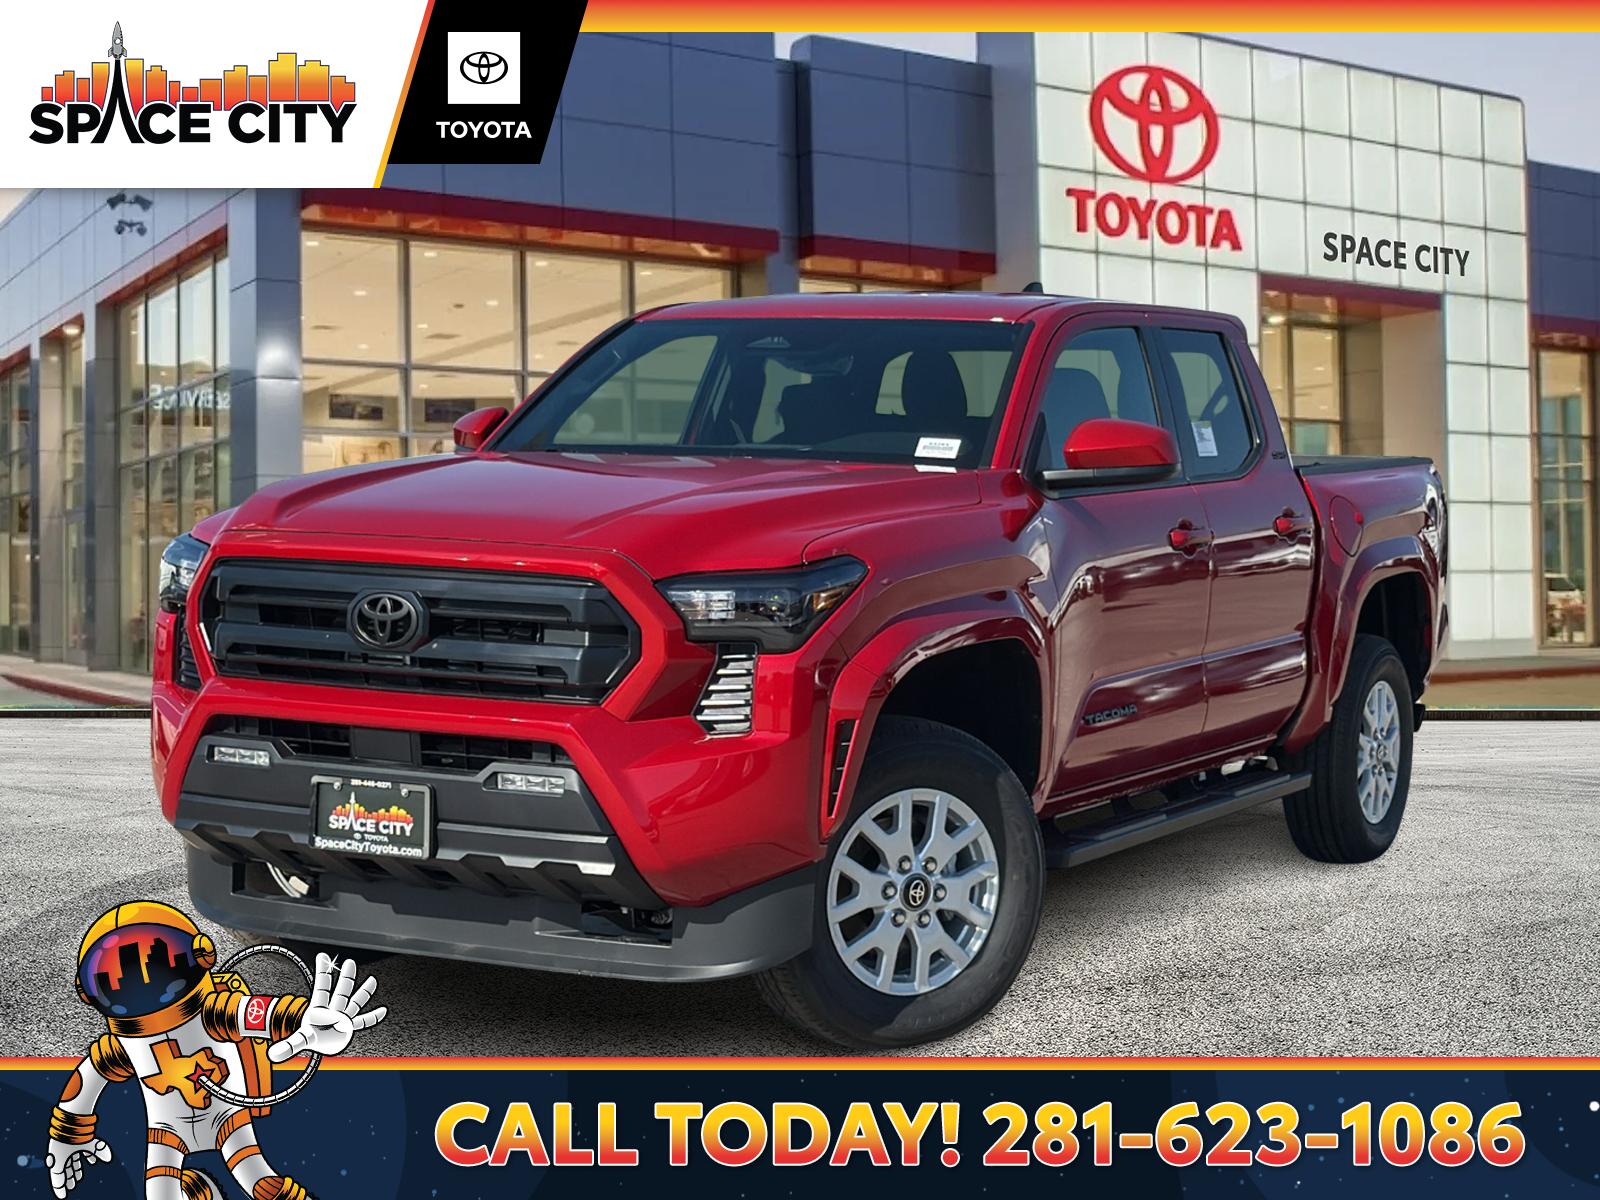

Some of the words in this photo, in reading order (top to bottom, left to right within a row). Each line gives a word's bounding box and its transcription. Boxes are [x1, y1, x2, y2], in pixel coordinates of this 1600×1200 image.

[1066, 187, 1242, 252] TOYOTA
[1323, 232, 1406, 269] SPACE
[1414, 244, 1469, 276] CITY
[1084, 704, 1137, 725] TACOMA
[328, 812, 376, 833] SPACE
[379, 820, 413, 837] CITY
[315, 837, 422, 857] SpaceCityToyota.com
[364, 833, 388, 843] TOYOTA
